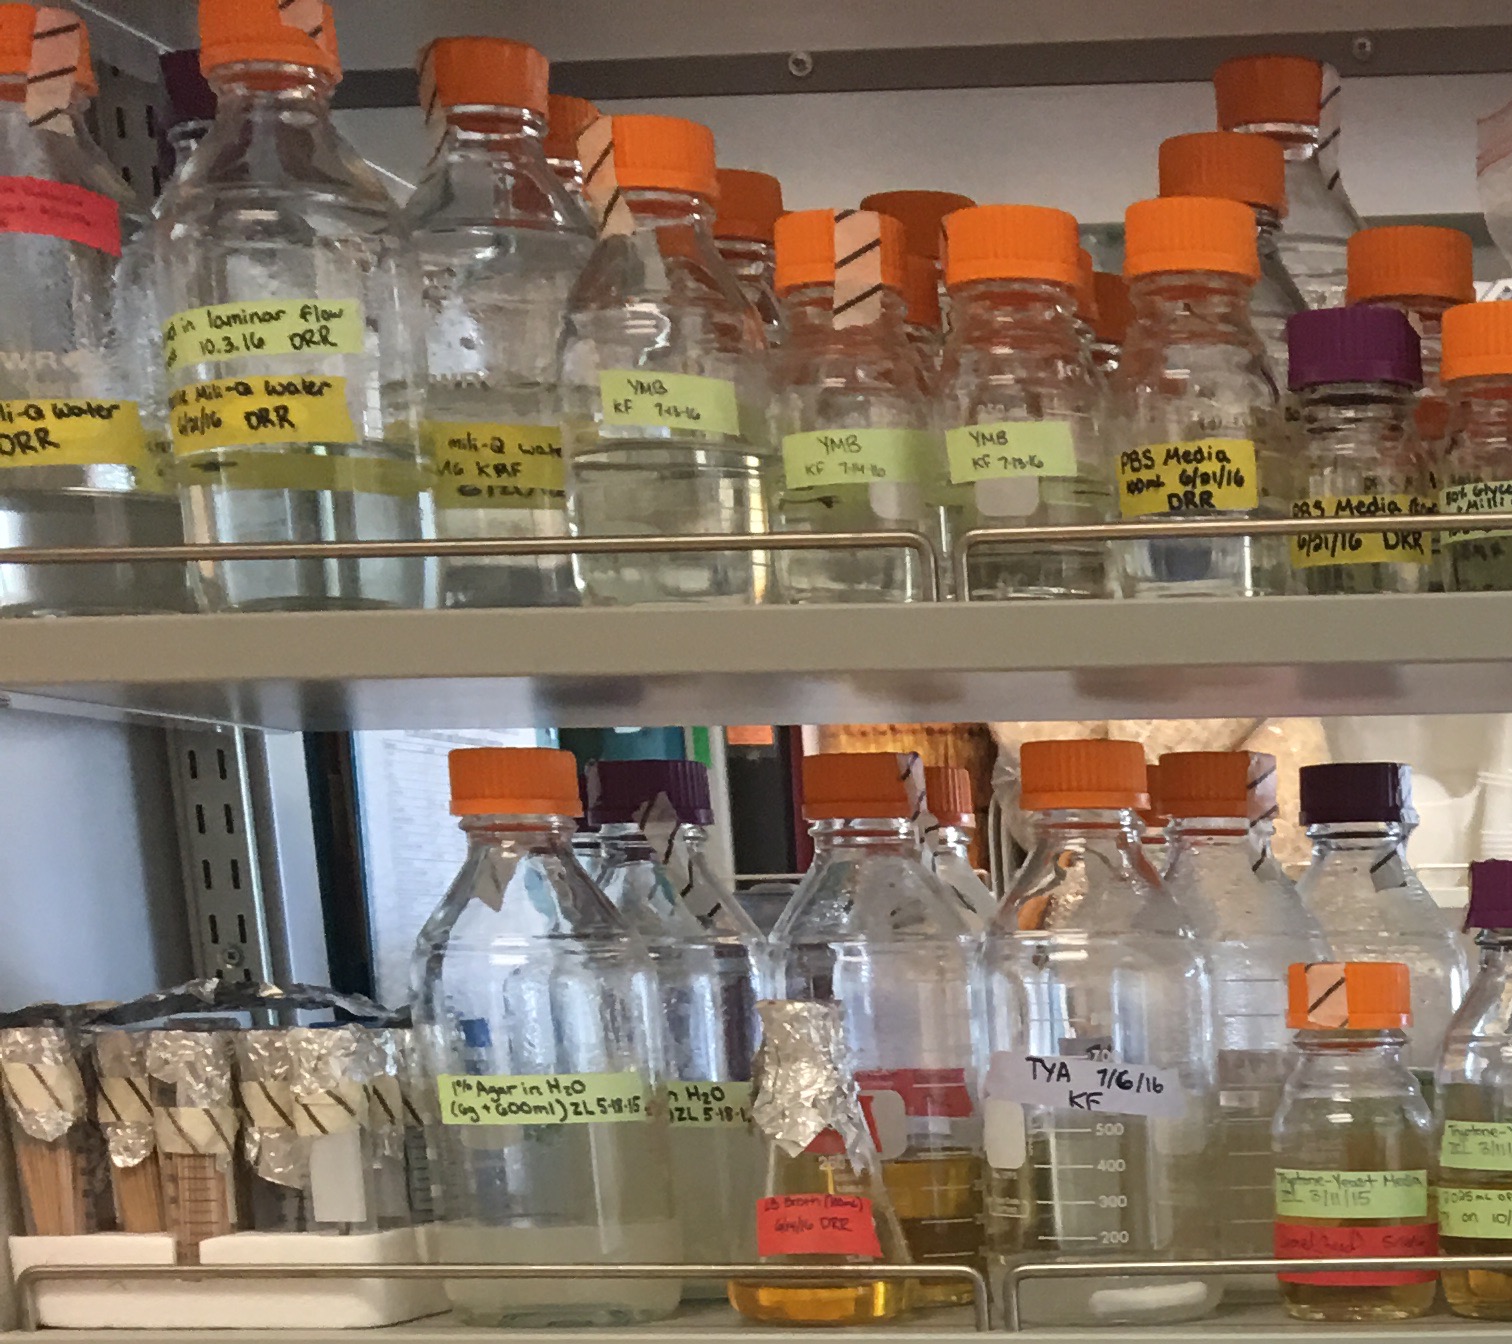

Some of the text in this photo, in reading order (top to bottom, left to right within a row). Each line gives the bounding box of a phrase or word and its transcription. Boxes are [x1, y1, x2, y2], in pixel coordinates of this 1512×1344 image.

[207, 309, 286, 330] laminar
[264, 377, 332, 397] water
[627, 378, 668, 396] YMB
[816, 434, 863, 456] YMB
[969, 430, 1009, 448] YMB
[1120, 445, 1232, 475] PBS Media
[1166, 489, 1217, 511] DRR
[1334, 496, 1403, 516] Media
[1025, 1056, 1071, 1083] TYA
[476, 1081, 518, 1102] Agar
[521, 1082, 544, 1097] in
[1068, 1090, 1104, 1111] KF
[1095, 1123, 1125, 1136] 500
[1097, 1159, 1127, 1172] 400
[1098, 1196, 1128, 1208] 300
[1101, 1230, 1130, 1243] 200
